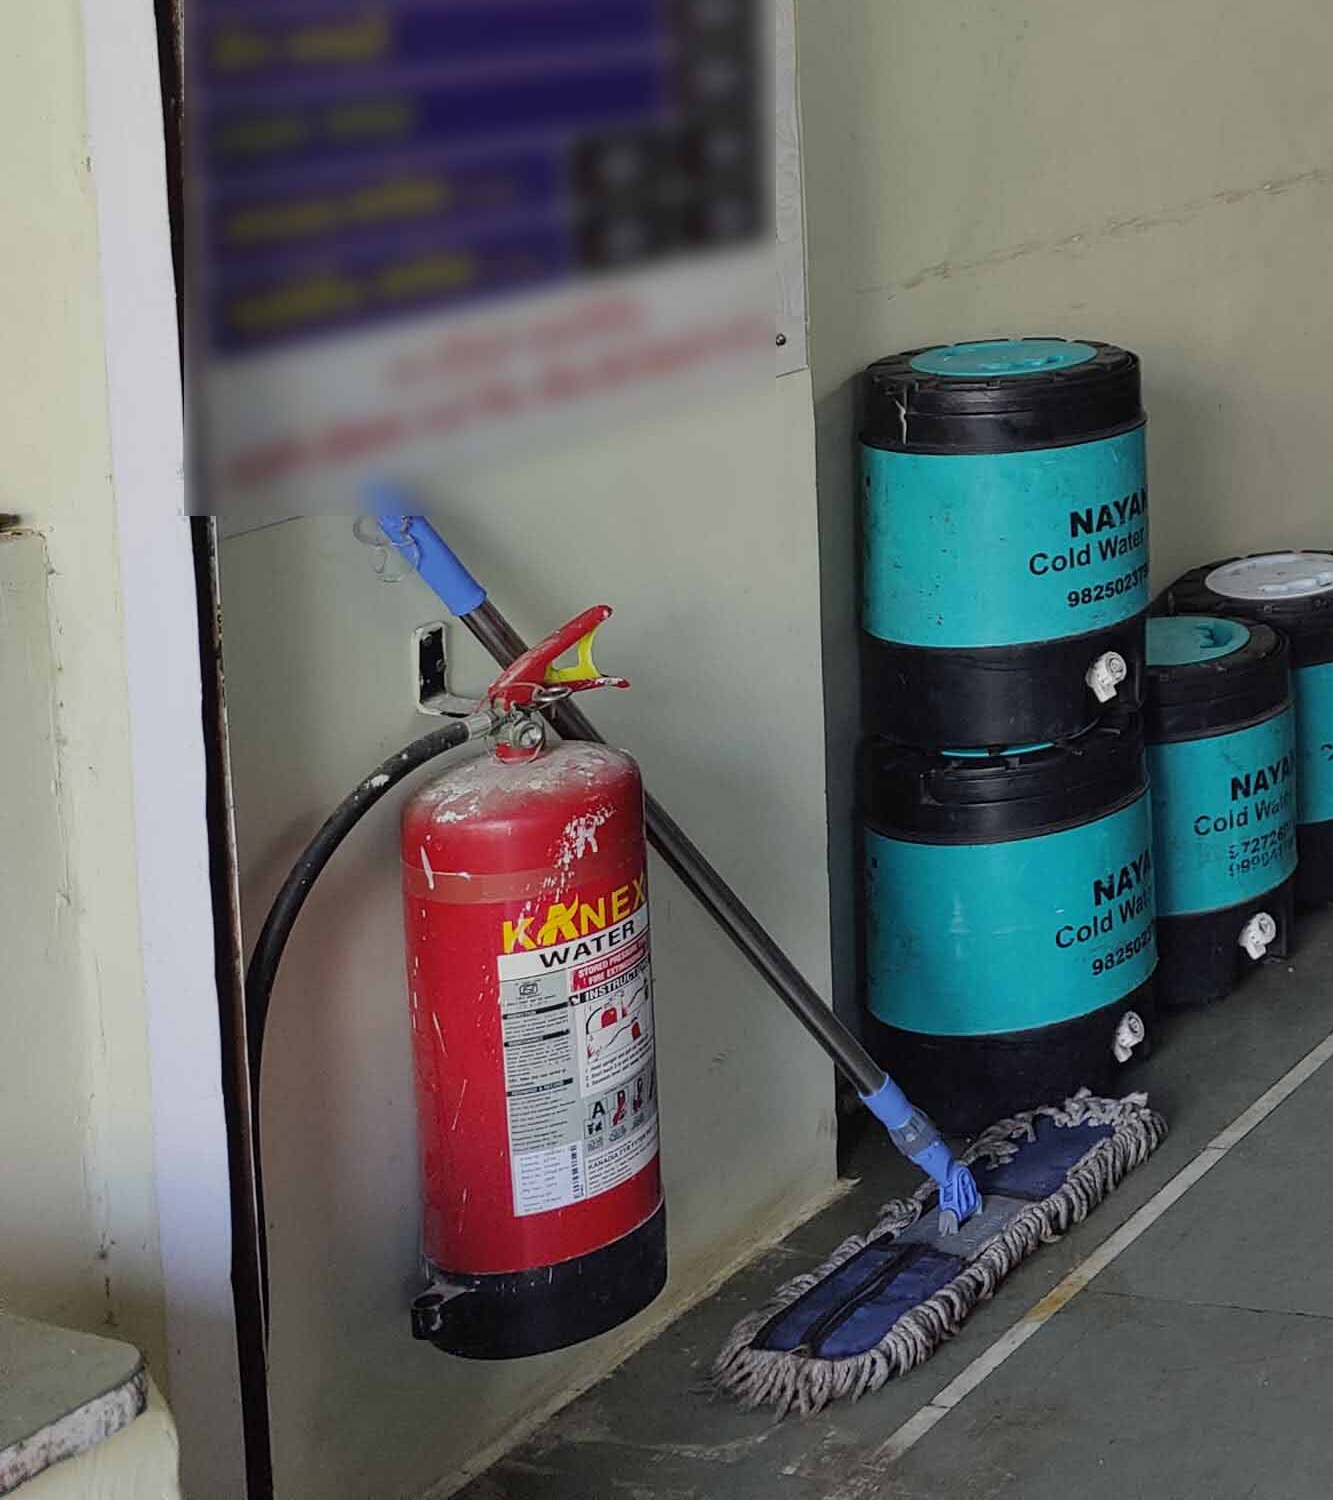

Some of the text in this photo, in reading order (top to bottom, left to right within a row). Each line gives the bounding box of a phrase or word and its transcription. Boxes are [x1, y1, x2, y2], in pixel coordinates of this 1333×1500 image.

[1029, 527, 1145, 575] Cold Water
[1194, 805, 1248, 836] Cold
[502, 871, 646, 954] KANEX
[1055, 908, 1112, 948] Cold
[540, 920, 635, 968] WATER
[578, 960, 609, 978] STORED
[588, 974, 606, 986] FIRE
[592, 1100, 605, 1119] A
